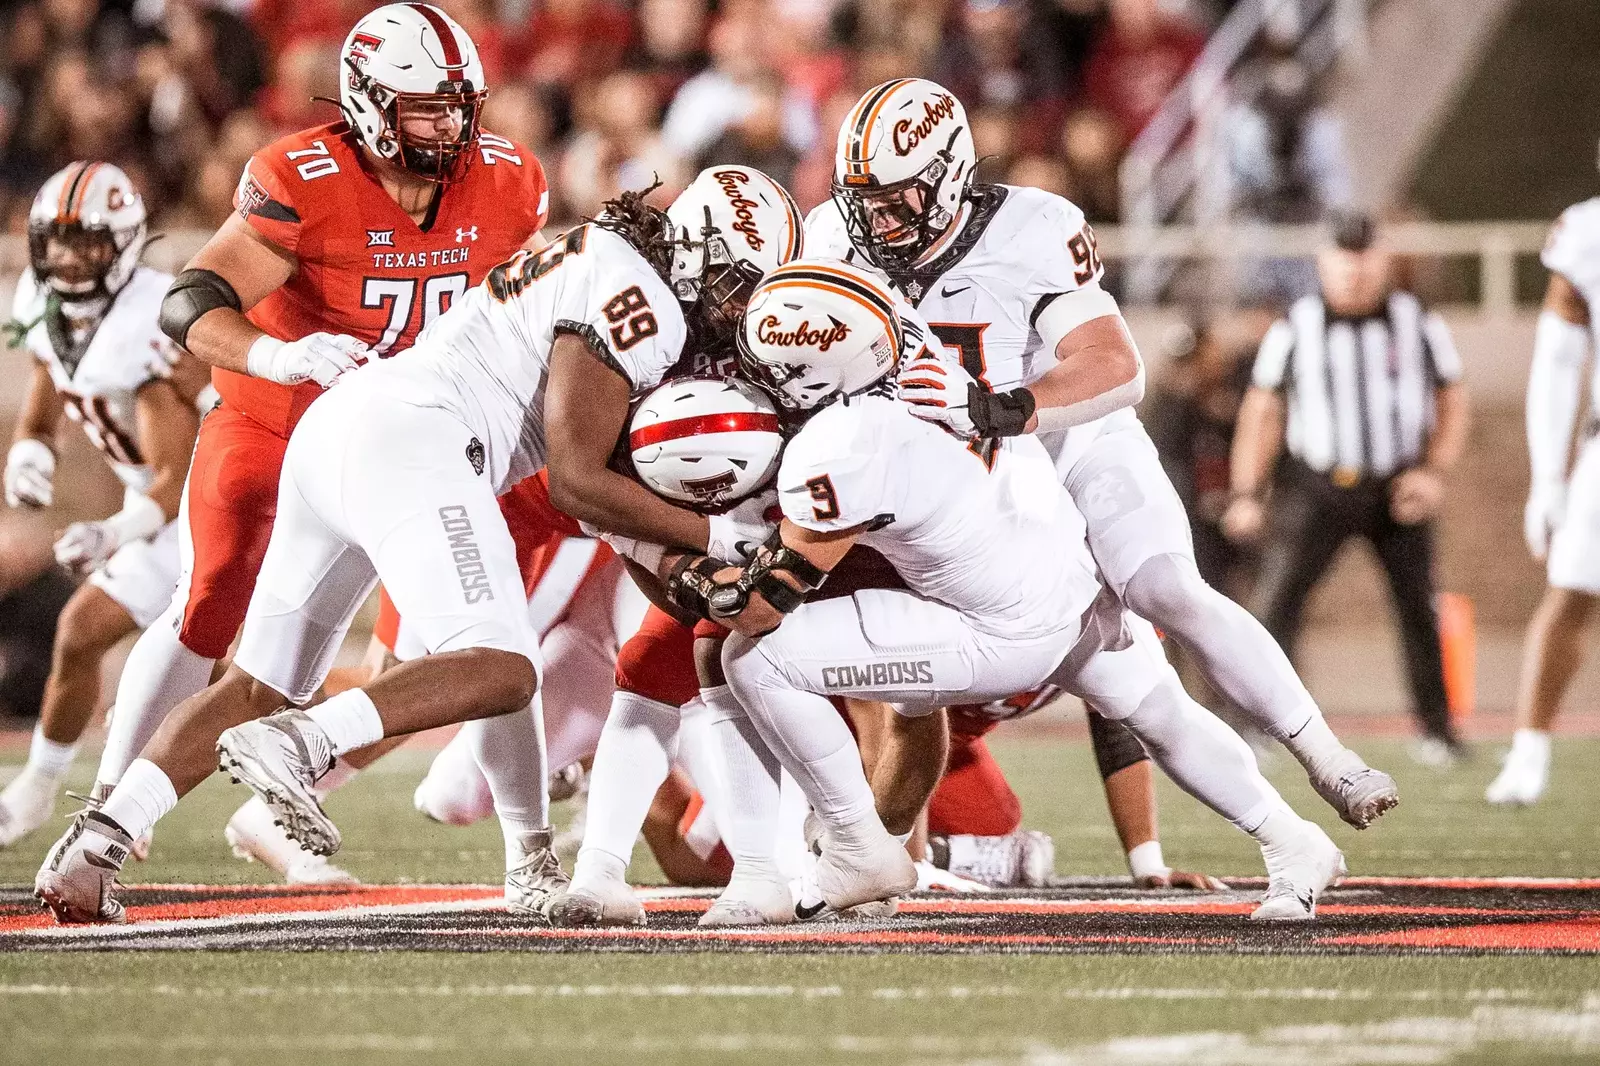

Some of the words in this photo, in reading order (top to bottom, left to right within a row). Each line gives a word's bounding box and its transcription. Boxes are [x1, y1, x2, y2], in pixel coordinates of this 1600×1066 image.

[892, 93, 955, 156] Cowboys
[285, 140, 339, 182] 70
[712, 170, 766, 252] Cowboys
[373, 252, 427, 268] TEXAS
[430, 247, 469, 266] TECH
[601, 285, 659, 352] 89
[758, 315, 852, 351] Cowboys
[806, 472, 841, 521] 9
[438, 505, 495, 605] COWBOYS
[821, 660, 934, 688] COWBOYS
[104, 843, 127, 865] NIKE
